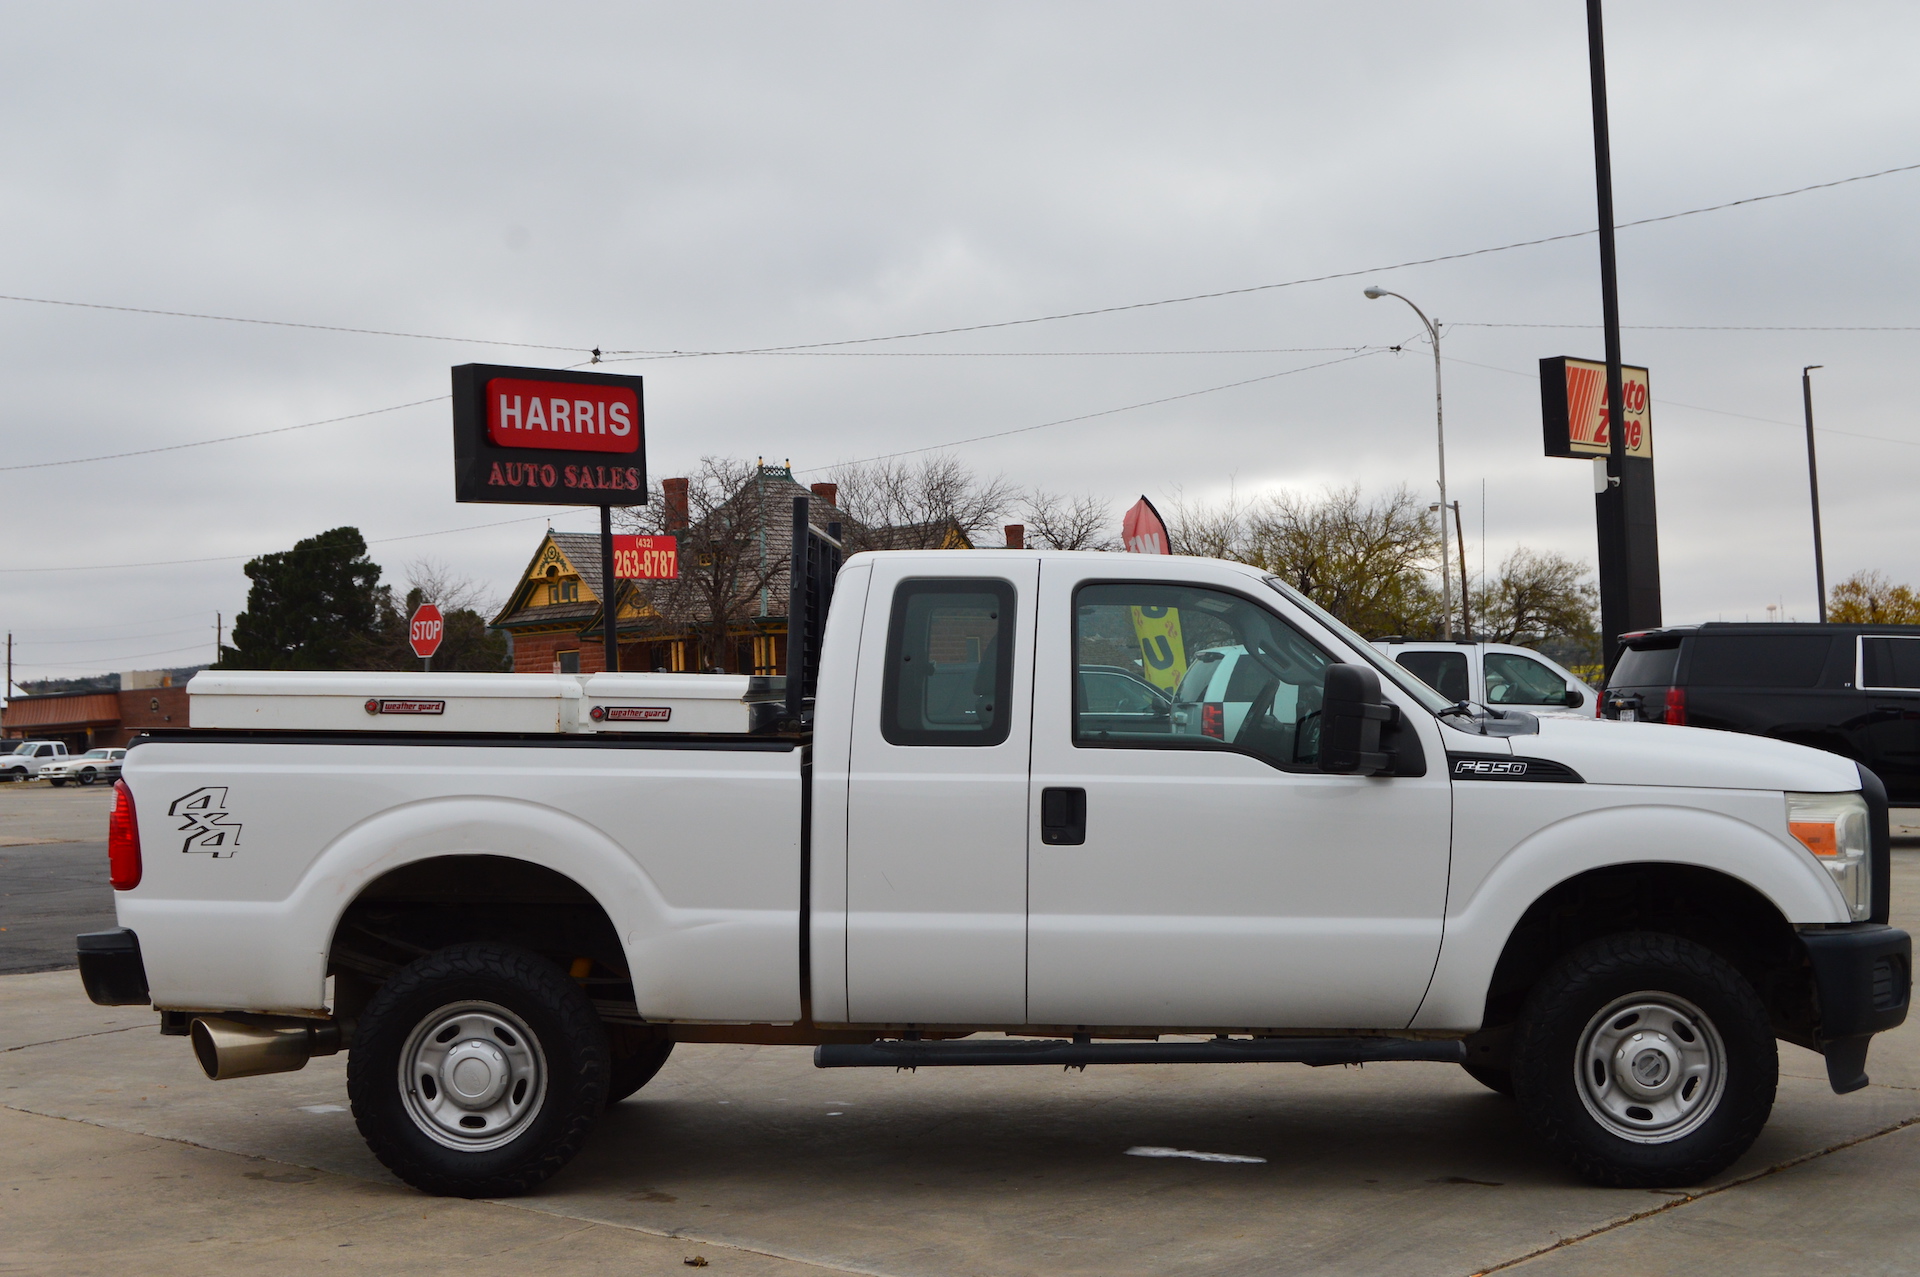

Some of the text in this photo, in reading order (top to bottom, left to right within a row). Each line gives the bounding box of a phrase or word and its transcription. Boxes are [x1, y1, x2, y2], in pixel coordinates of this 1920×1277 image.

[499, 394, 631, 437] HARRIS
[1593, 408, 1641, 447] Zne
[488, 461, 640, 490] AUTO SALES
[635, 537, 654, 549] (432)
[614, 550, 676, 577] 263-8787
[412, 620, 441, 641] STOP
[384, 702, 441, 712] weather guard
[610, 709, 667, 718] weather guard
[1454, 760, 1528, 776] F-350
